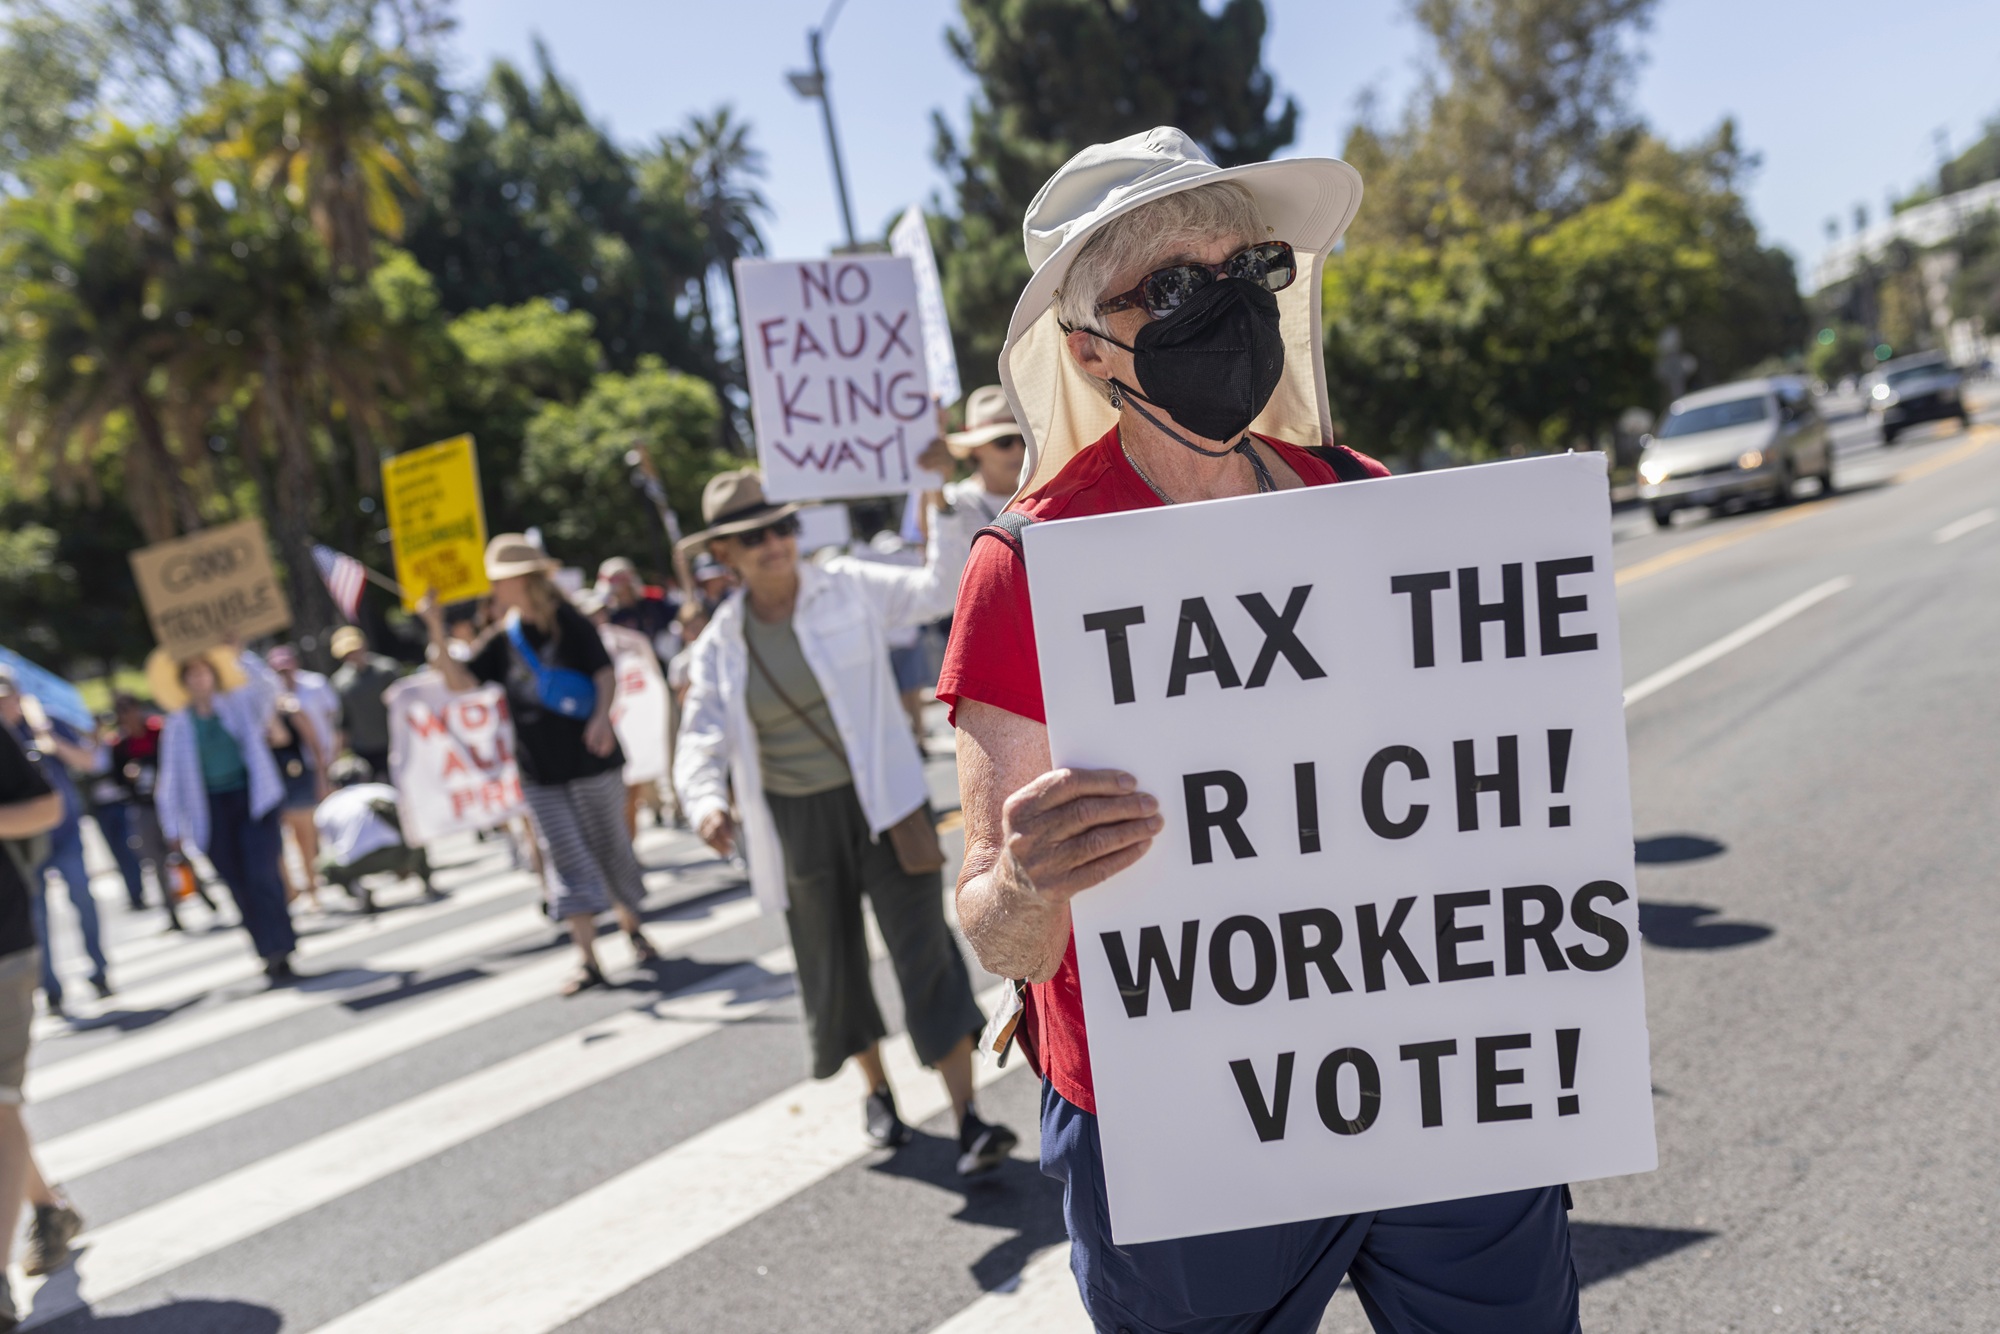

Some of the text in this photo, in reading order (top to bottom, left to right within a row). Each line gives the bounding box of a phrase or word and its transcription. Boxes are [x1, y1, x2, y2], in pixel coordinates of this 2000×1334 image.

[798, 262, 871, 309] NO
[758, 311, 914, 371] FAUX
[775, 370, 929, 436] KING
[773, 424, 910, 482] WAY!
[1082, 555, 1598, 705] TAX THE
[1182, 728, 1573, 866] RICH!
[1099, 879, 1630, 1019] WORKERS
[1228, 1027, 1581, 1143] VOTE!
